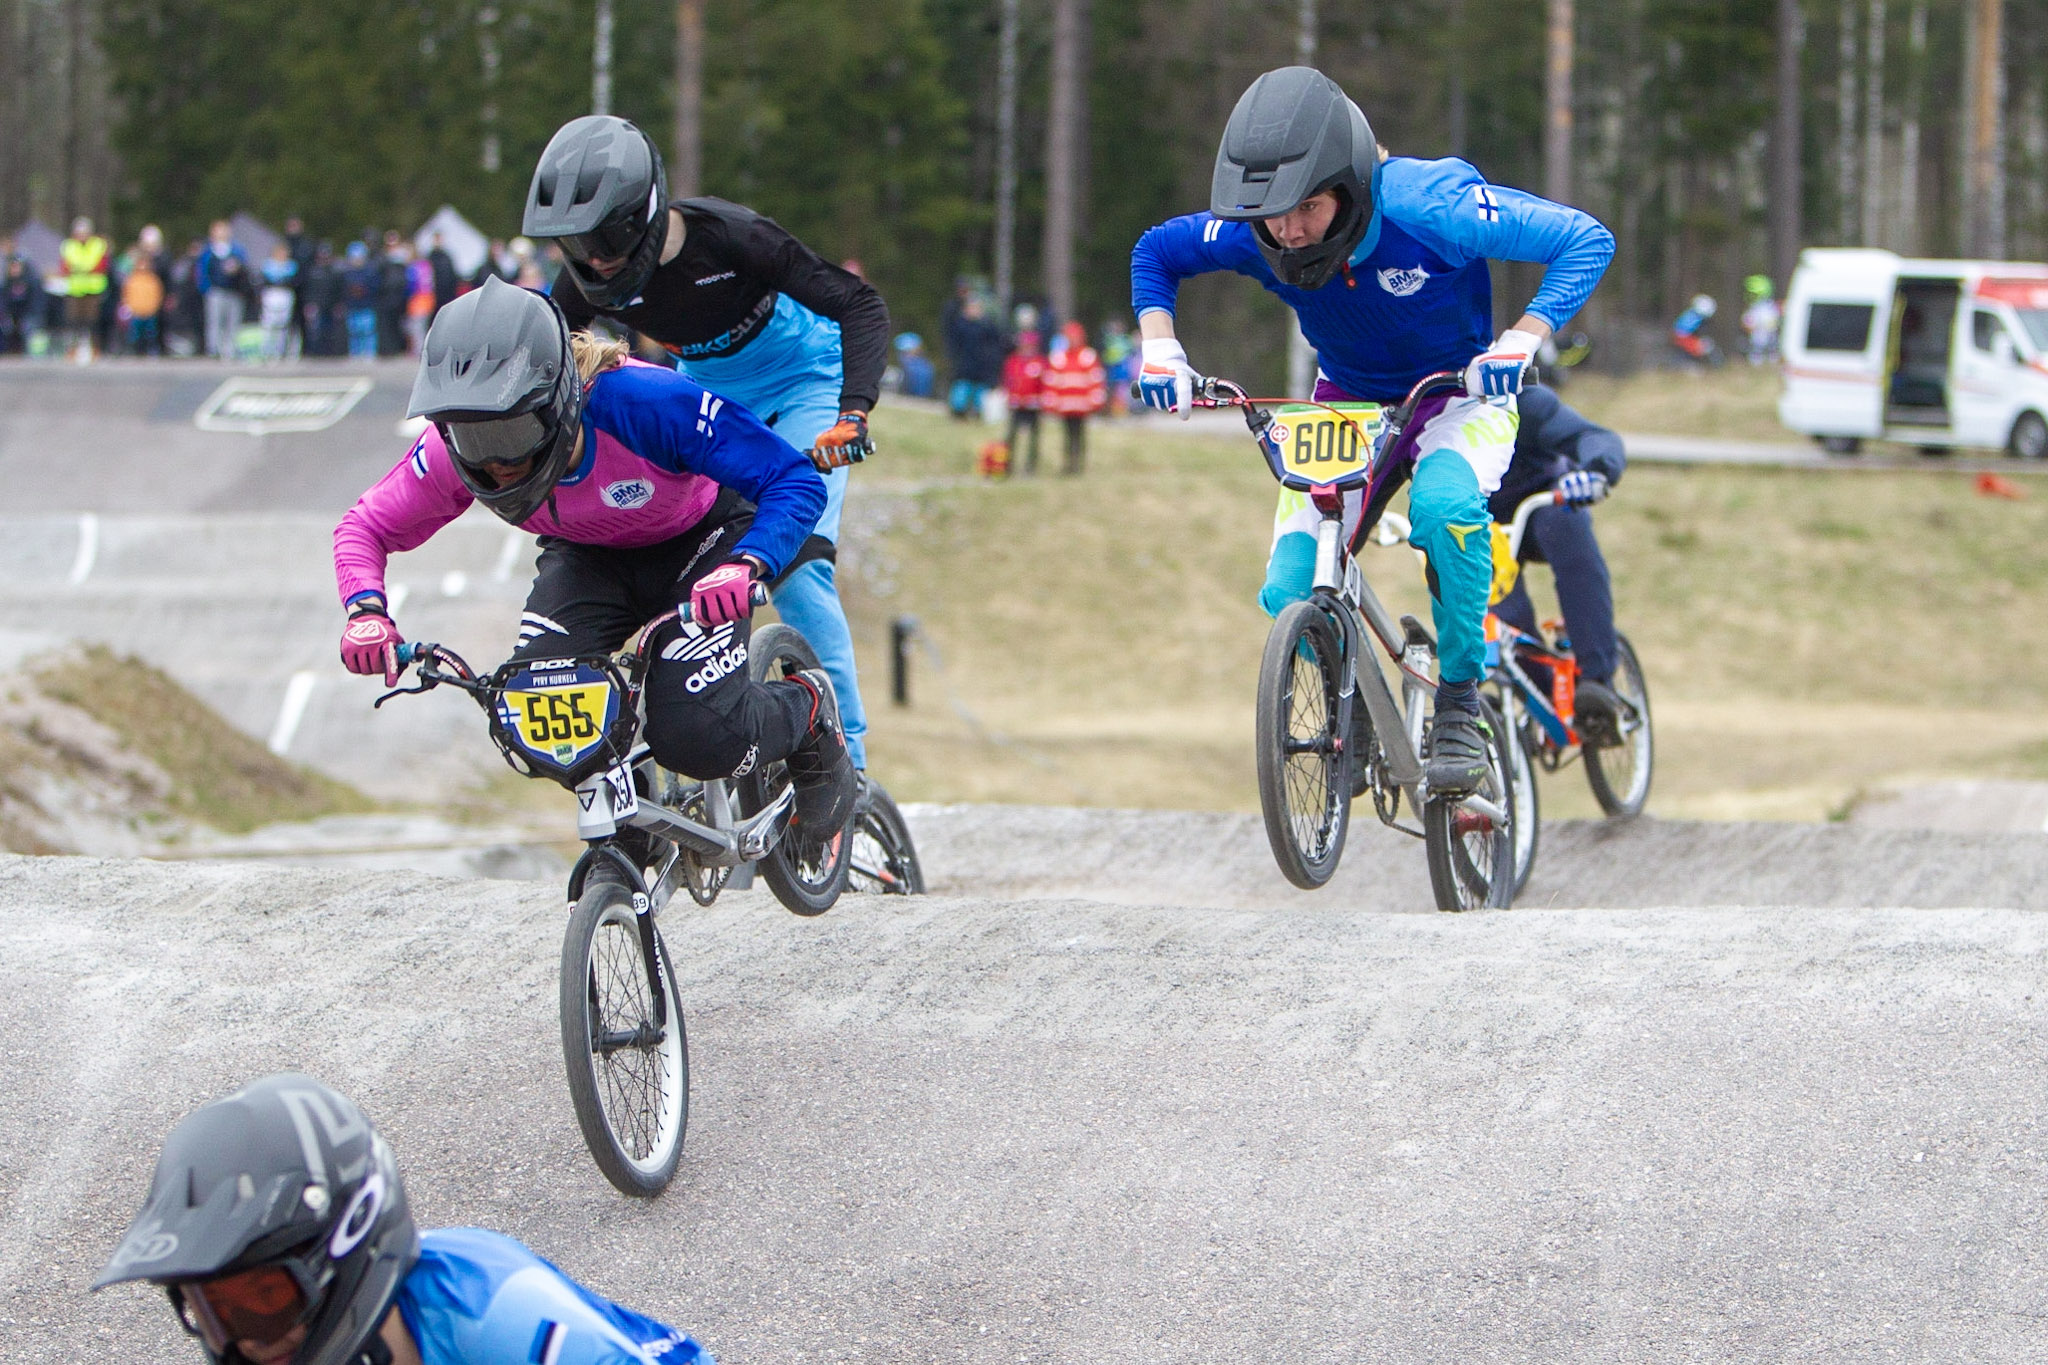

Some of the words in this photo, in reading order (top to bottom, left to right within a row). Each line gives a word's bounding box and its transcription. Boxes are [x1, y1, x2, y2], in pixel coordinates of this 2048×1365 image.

[1295, 420, 1358, 465] 600
[611, 482, 645, 503] BMX
[432, 649, 462, 674] ENTHAL
[530, 658, 576, 671] BOX
[685, 643, 748, 693] adidas
[533, 676, 548, 686] PYRY
[549, 673, 578, 685] KURKELA
[526, 692, 594, 741] 555
